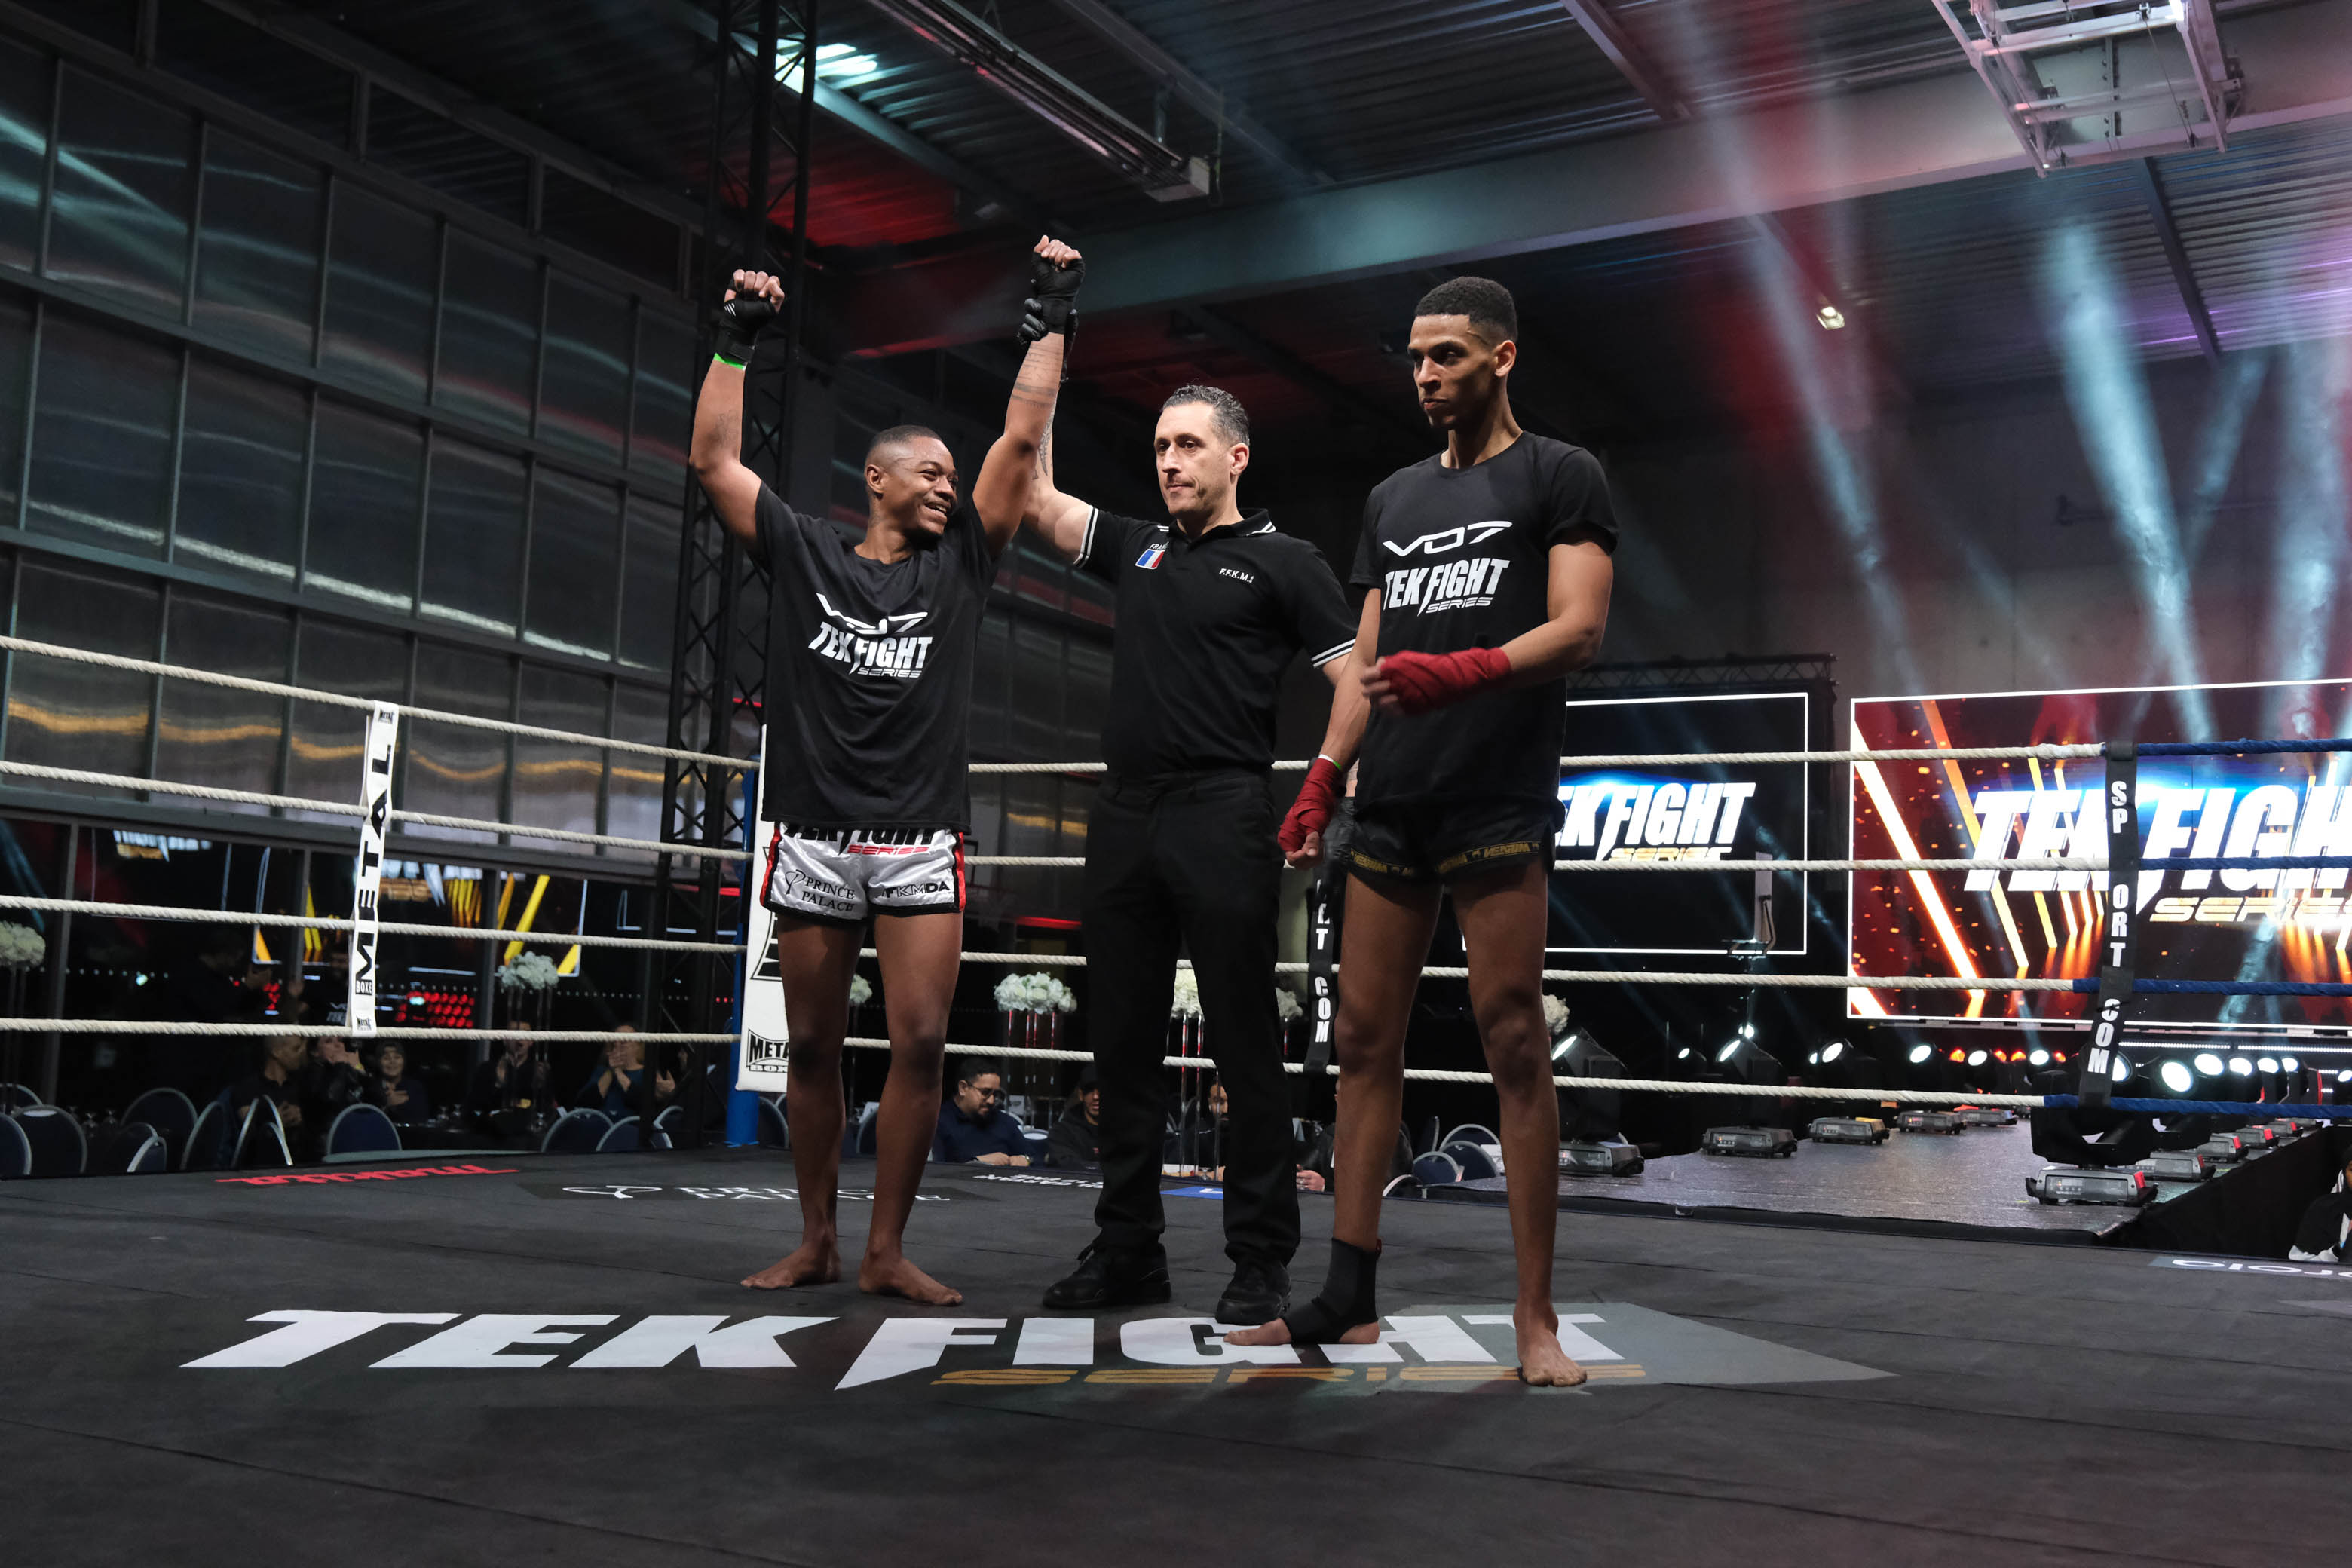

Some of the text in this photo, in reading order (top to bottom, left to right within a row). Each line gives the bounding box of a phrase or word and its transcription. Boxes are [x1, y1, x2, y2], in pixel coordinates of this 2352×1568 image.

[1383, 557, 1510, 617] TEK FIGHT
[1426, 596, 1493, 614] SERIES
[808, 621, 933, 675] TEK FIGHT
[857, 666, 923, 678] SERIES
[1595, 782, 1756, 862] FIGHT
[356, 744, 392, 980] METAL
[847, 844, 930, 856] SERIES
[2136, 784, 2352, 914] FIGH
[801, 890, 853, 912] PALACE
[806, 877, 855, 900] PRINCE
[881, 880, 950, 899] FKMDA
[355, 981, 373, 995] BOXE
[1315, 976, 1331, 1043] COM
[749, 1033, 789, 1064] META
[2087, 998, 2121, 1075] COM
[749, 1063, 789, 1073] BOX
[691, 1192, 950, 1201] PALE
[179, 1309, 1625, 1391] TEK FIGHT
